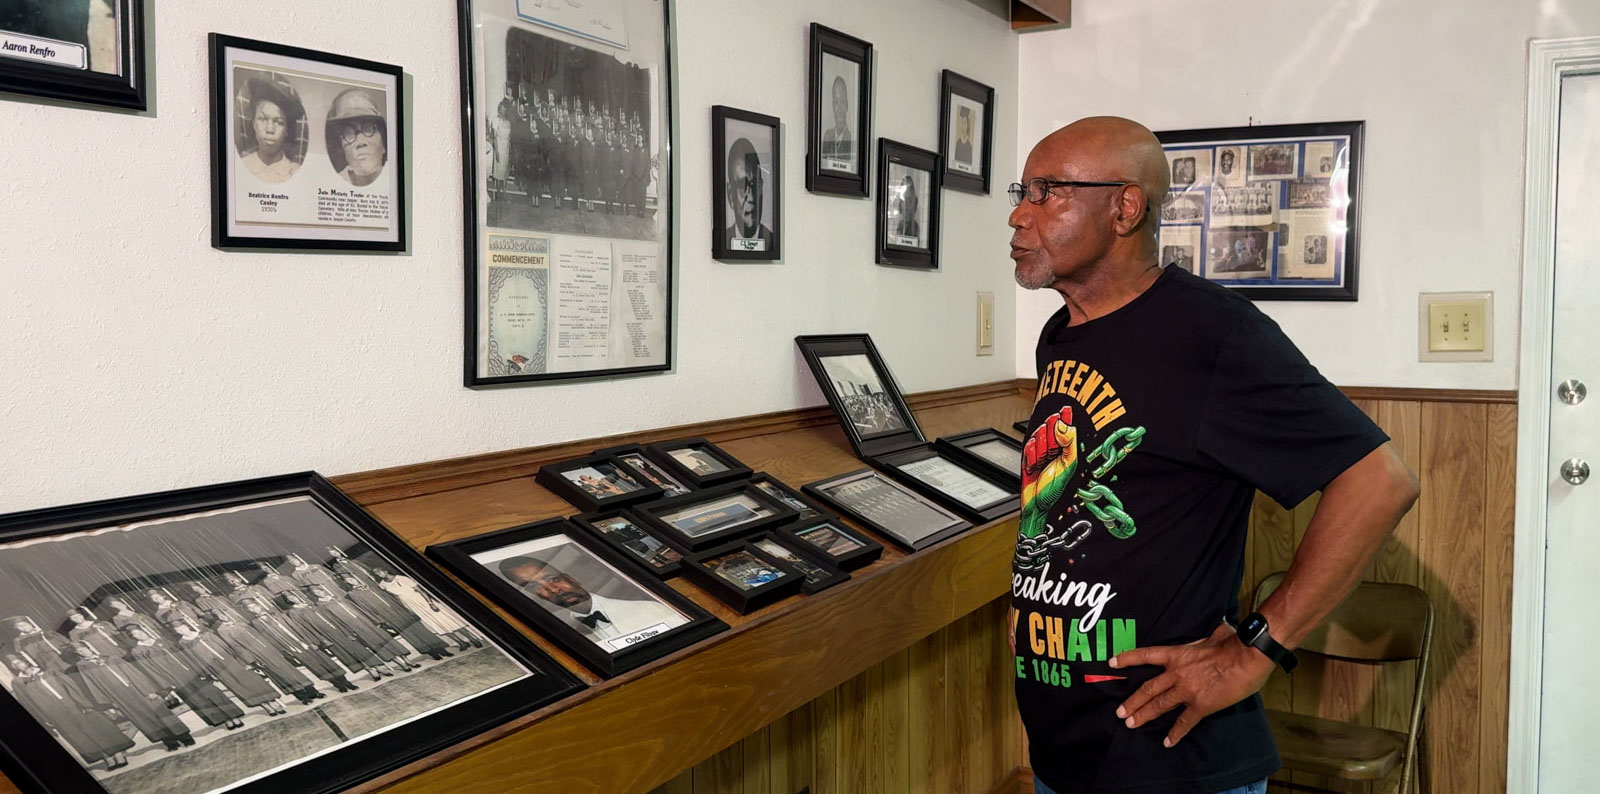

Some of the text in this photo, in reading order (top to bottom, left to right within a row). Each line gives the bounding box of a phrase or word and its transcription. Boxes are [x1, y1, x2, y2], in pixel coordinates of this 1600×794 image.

[2, 40, 56, 58] Aaron Renfro
[492, 254, 544, 265] COMMENCEMENT
[1032, 360, 1126, 431] ETEENTH
[1011, 562, 1117, 633] eaking
[1028, 612, 1136, 662] CHAIN
[1032, 658, 1072, 688] 1865
